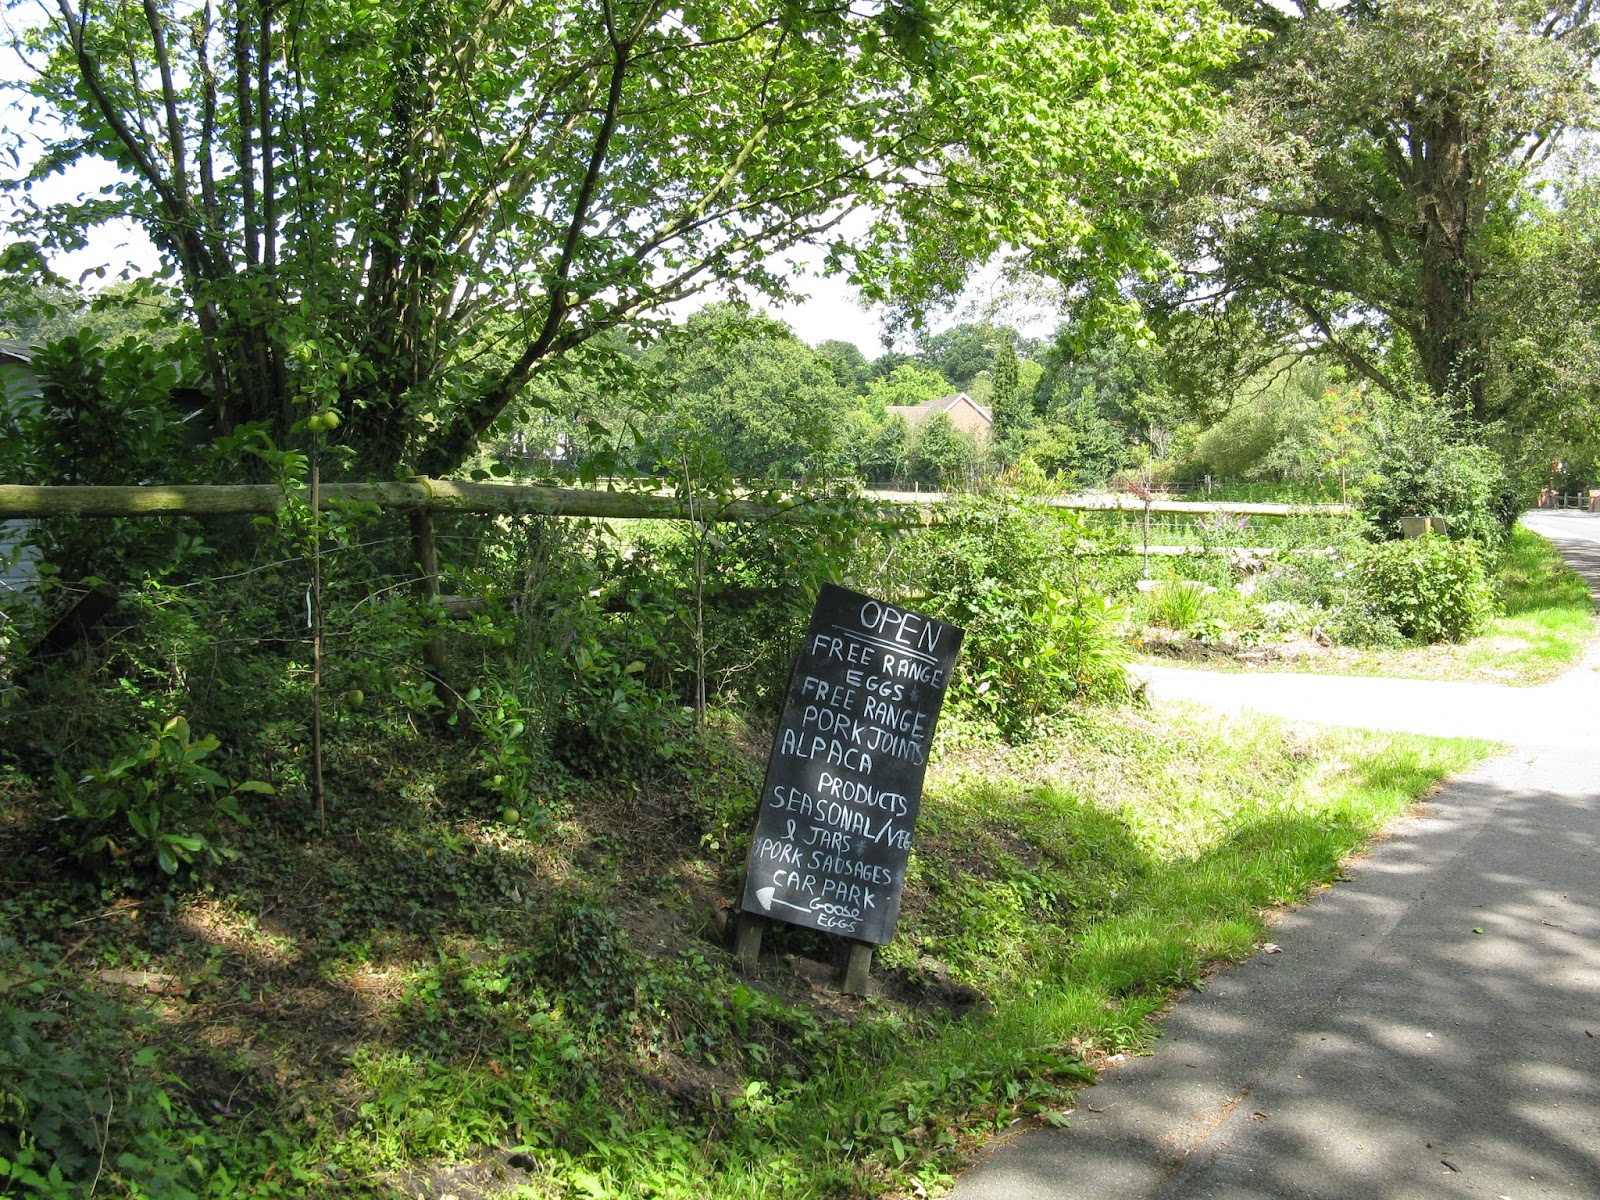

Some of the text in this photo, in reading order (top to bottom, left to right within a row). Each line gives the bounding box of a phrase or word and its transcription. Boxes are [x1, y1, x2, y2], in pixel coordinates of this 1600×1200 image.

[860, 601, 943, 652] OPEN
[812, 634, 944, 689] FREE RANGE
[802, 676, 926, 739] FREE RANGE
[846, 669, 904, 702] EGGS
[781, 728, 873, 775] ALPACA
[802, 705, 924, 766] PORK JOINTS
[817, 772, 907, 817] PRODUCTS
[760, 839, 892, 885] PORK SAUSAGES
[803, 826, 851, 853] JARS
[773, 869, 876, 909] CAR PARK
[817, 913, 856, 933] EGGS
